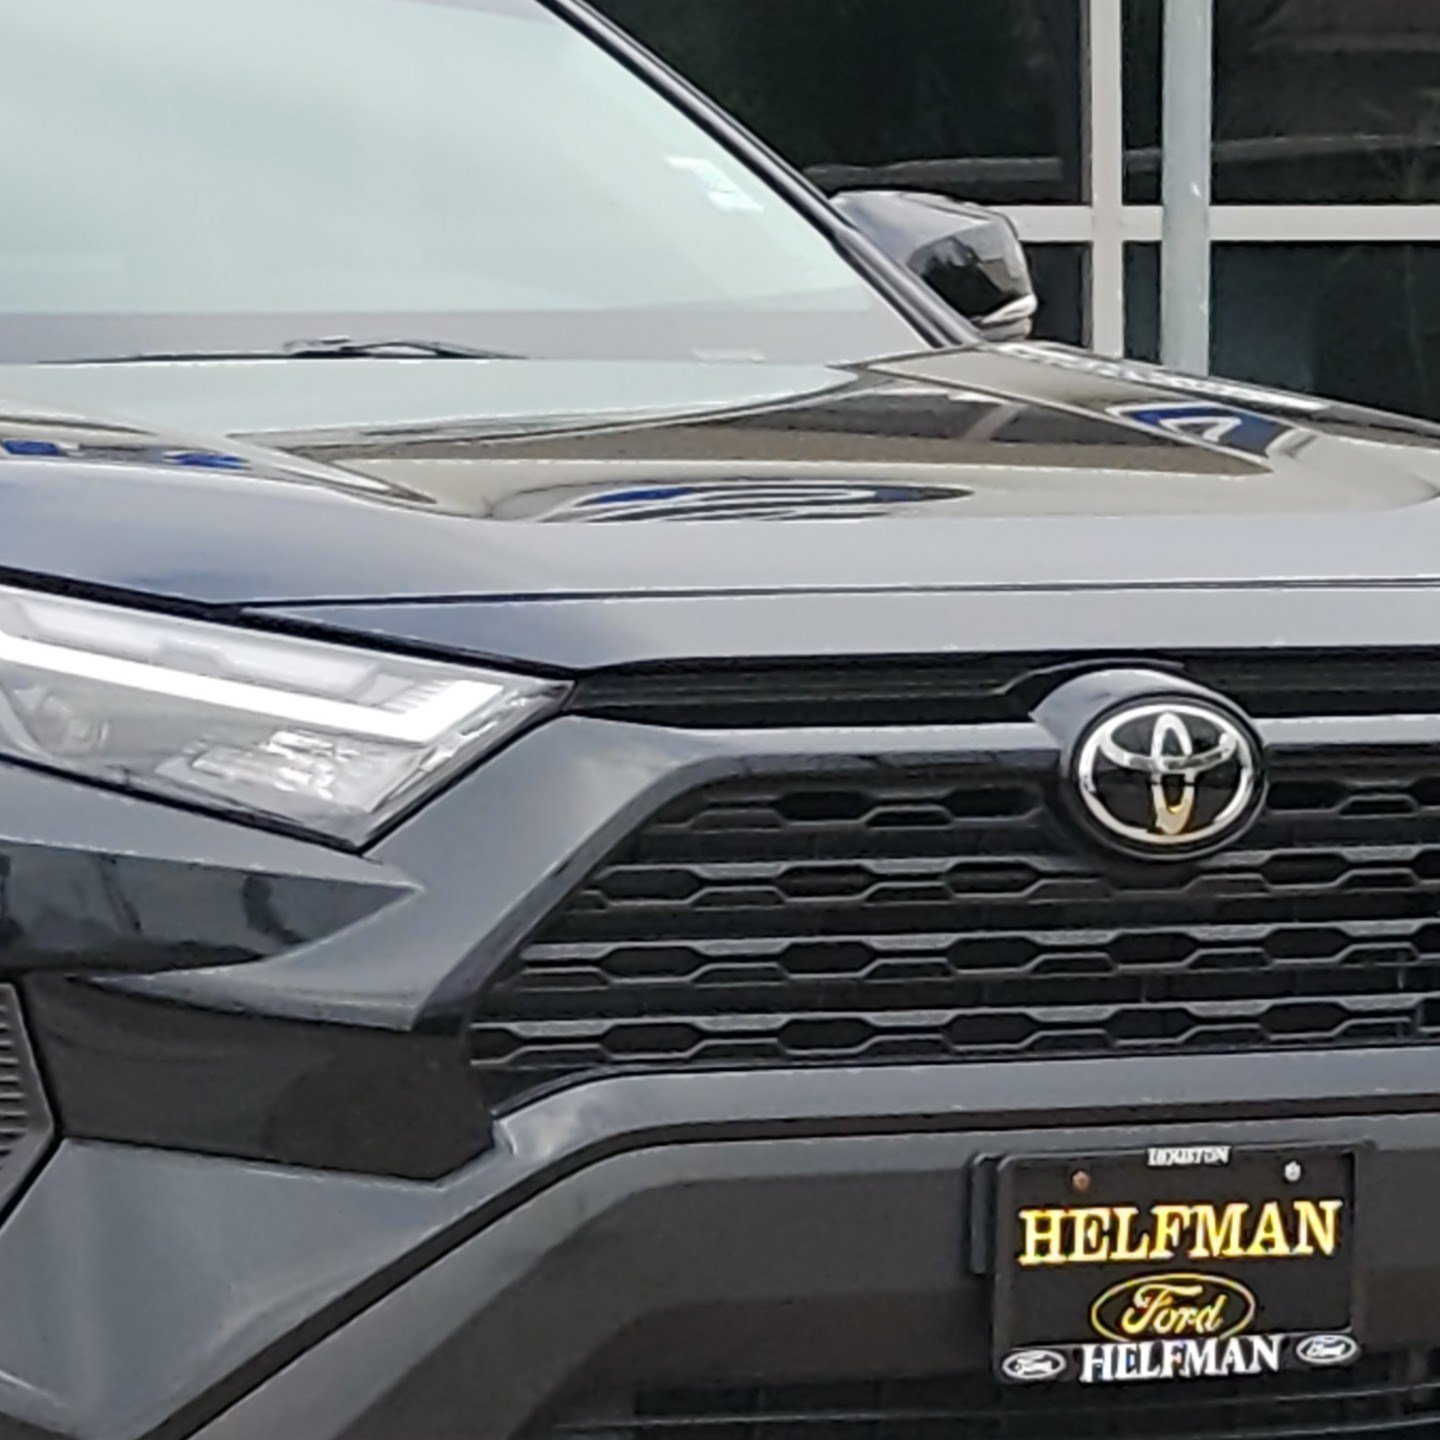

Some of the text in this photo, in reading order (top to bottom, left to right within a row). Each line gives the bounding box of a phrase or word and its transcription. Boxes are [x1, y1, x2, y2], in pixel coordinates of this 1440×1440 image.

[1018, 1199, 1343, 1266] HELFMAN
[1122, 1283, 1230, 1335] Ford
[1079, 1334, 1283, 1383] HELFMAN
